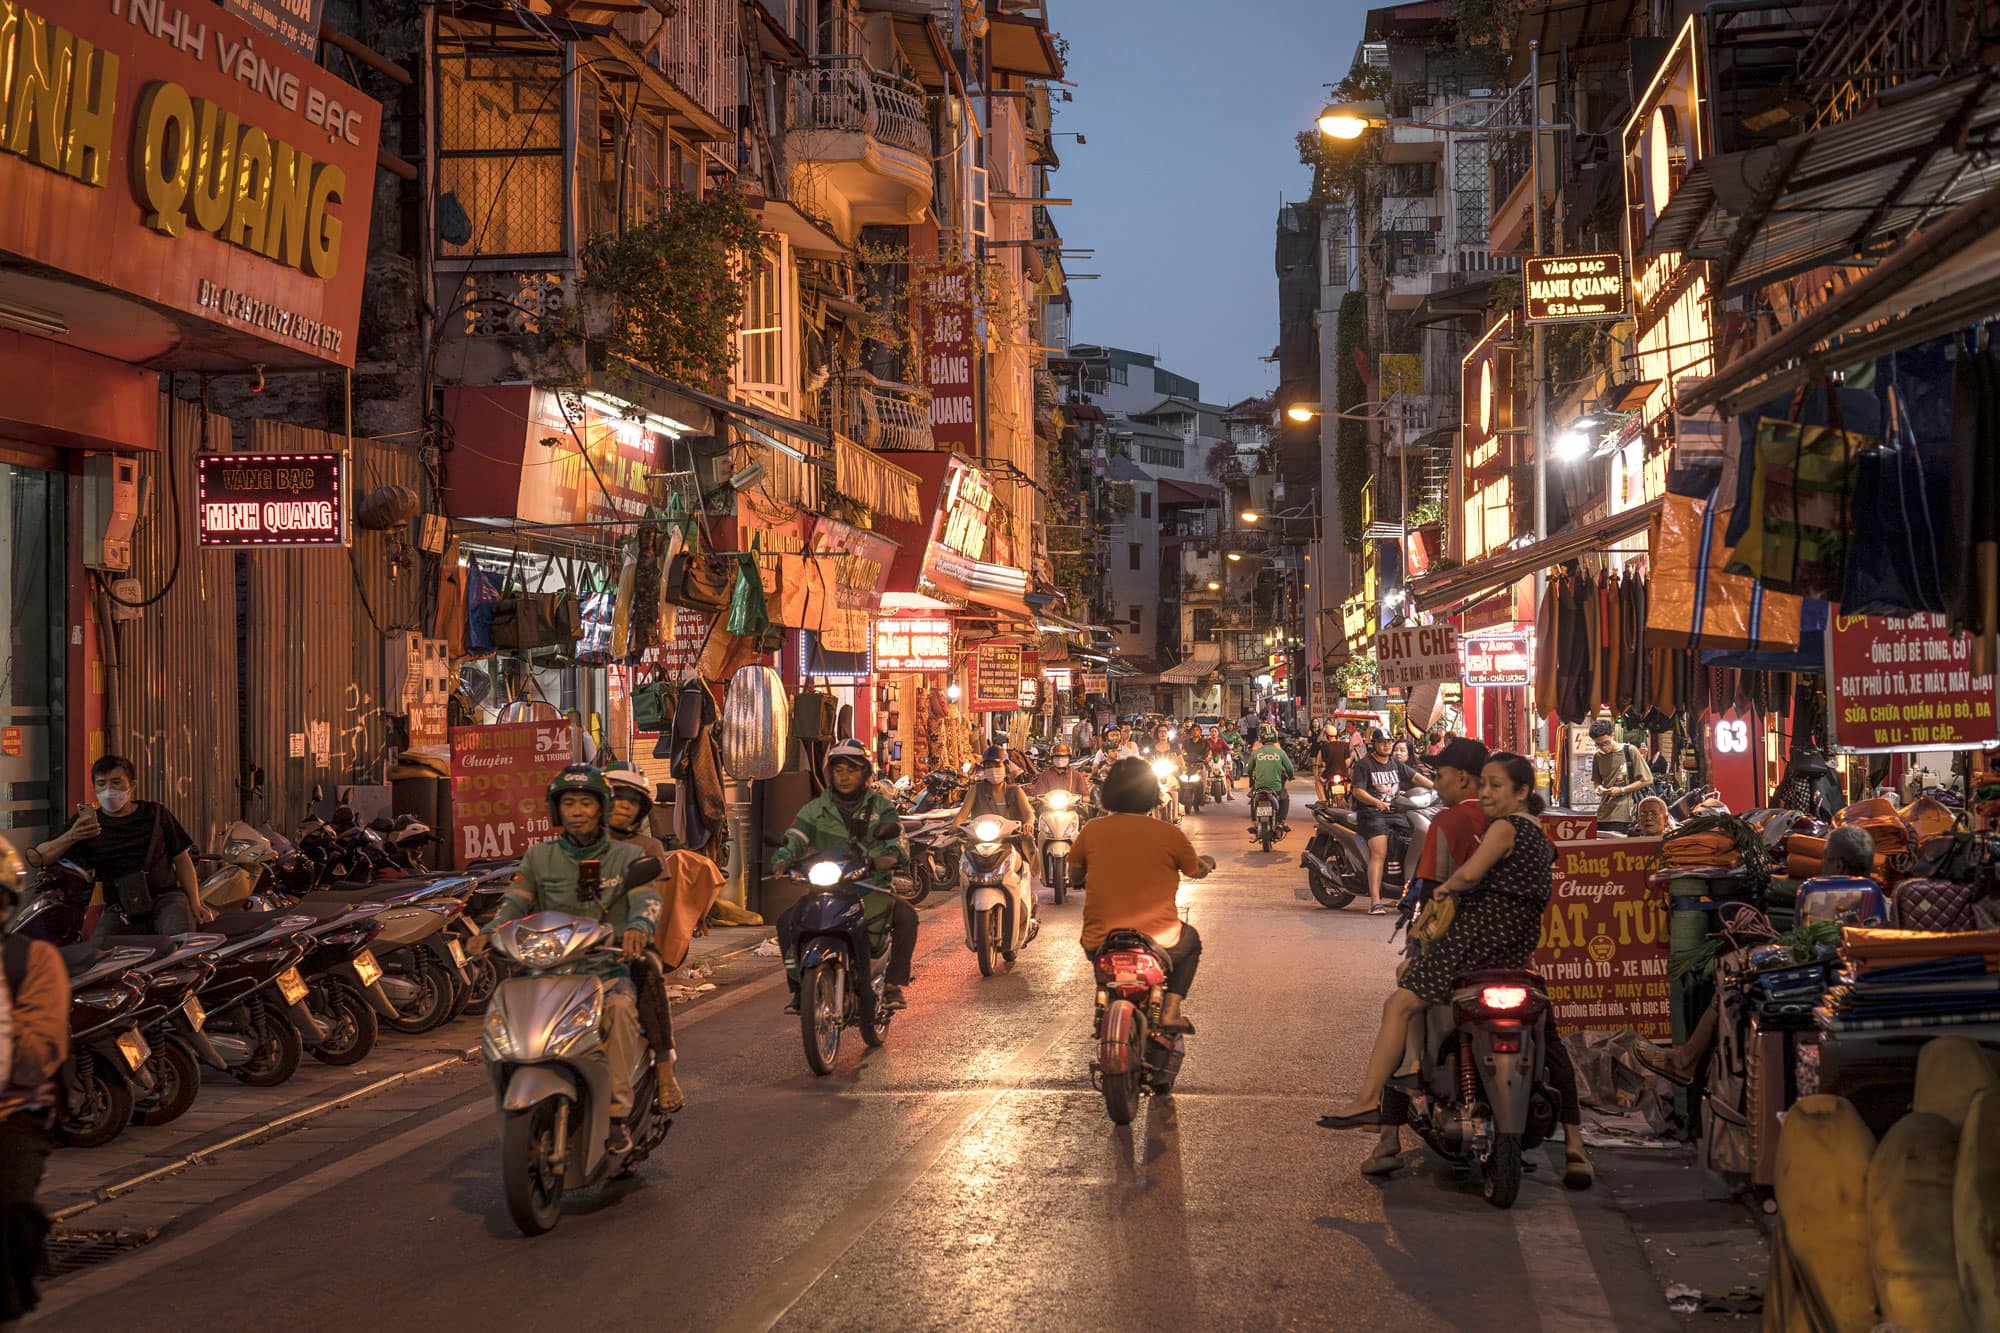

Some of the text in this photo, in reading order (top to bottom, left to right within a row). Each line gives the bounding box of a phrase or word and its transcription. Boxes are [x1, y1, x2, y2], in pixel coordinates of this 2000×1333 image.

[214, 32, 300, 112] VÀNG
[303, 86, 363, 147] BẠC
[143, 81, 346, 280] QUANG
[1543, 261, 1605, 274] VÀNG BẠC
[200, 279, 219, 309] ĐT:
[223, 288, 236, 316] 04
[1530, 276, 1620, 303] MẠNH QUANG
[1547, 303, 1565, 315] 63
[223, 464, 314, 494] VÀNG BẠC
[206, 502, 332, 532] MINH QUANG
[1378, 627, 1457, 665] BẠT CHE
[1909, 637, 1920, 661] BÊ
[1400, 667, 1409, 682] XE
[1410, 664, 1424, 681] MÁY
[1842, 677, 1860, 700] BẠT
[1862, 669, 1882, 696] PHỦ
[1884, 671, 1893, 695] Ô
[1909, 673, 1922, 693] XE
[1924, 668, 1947, 694] MÁY,
[1949, 668, 1970, 692] MÁY
[1976, 702, 1991, 717] DA
[536, 727, 570, 752] 54
[1715, 720, 1748, 752] 63
[1874, 728, 1888, 743] VA
[1891, 728, 1901, 743] LI
[1912, 724, 1929, 742] TÚI
[1257, 752, 1280, 761] Grab
[536, 816, 549, 831] TÔ
[1556, 820, 1592, 840] 67
[1558, 880, 1625, 904] Chuyên
[1557, 957, 1581, 980] PHỦ
[1584, 958, 1593, 978] Ô
[1622, 960, 1639, 977] XE
[1641, 954, 1668, 976] MÁY
[1573, 983, 1604, 999] VALY
[1615, 980, 1643, 997] MÁY
[1642, 1001, 1659, 1018] BỌC
